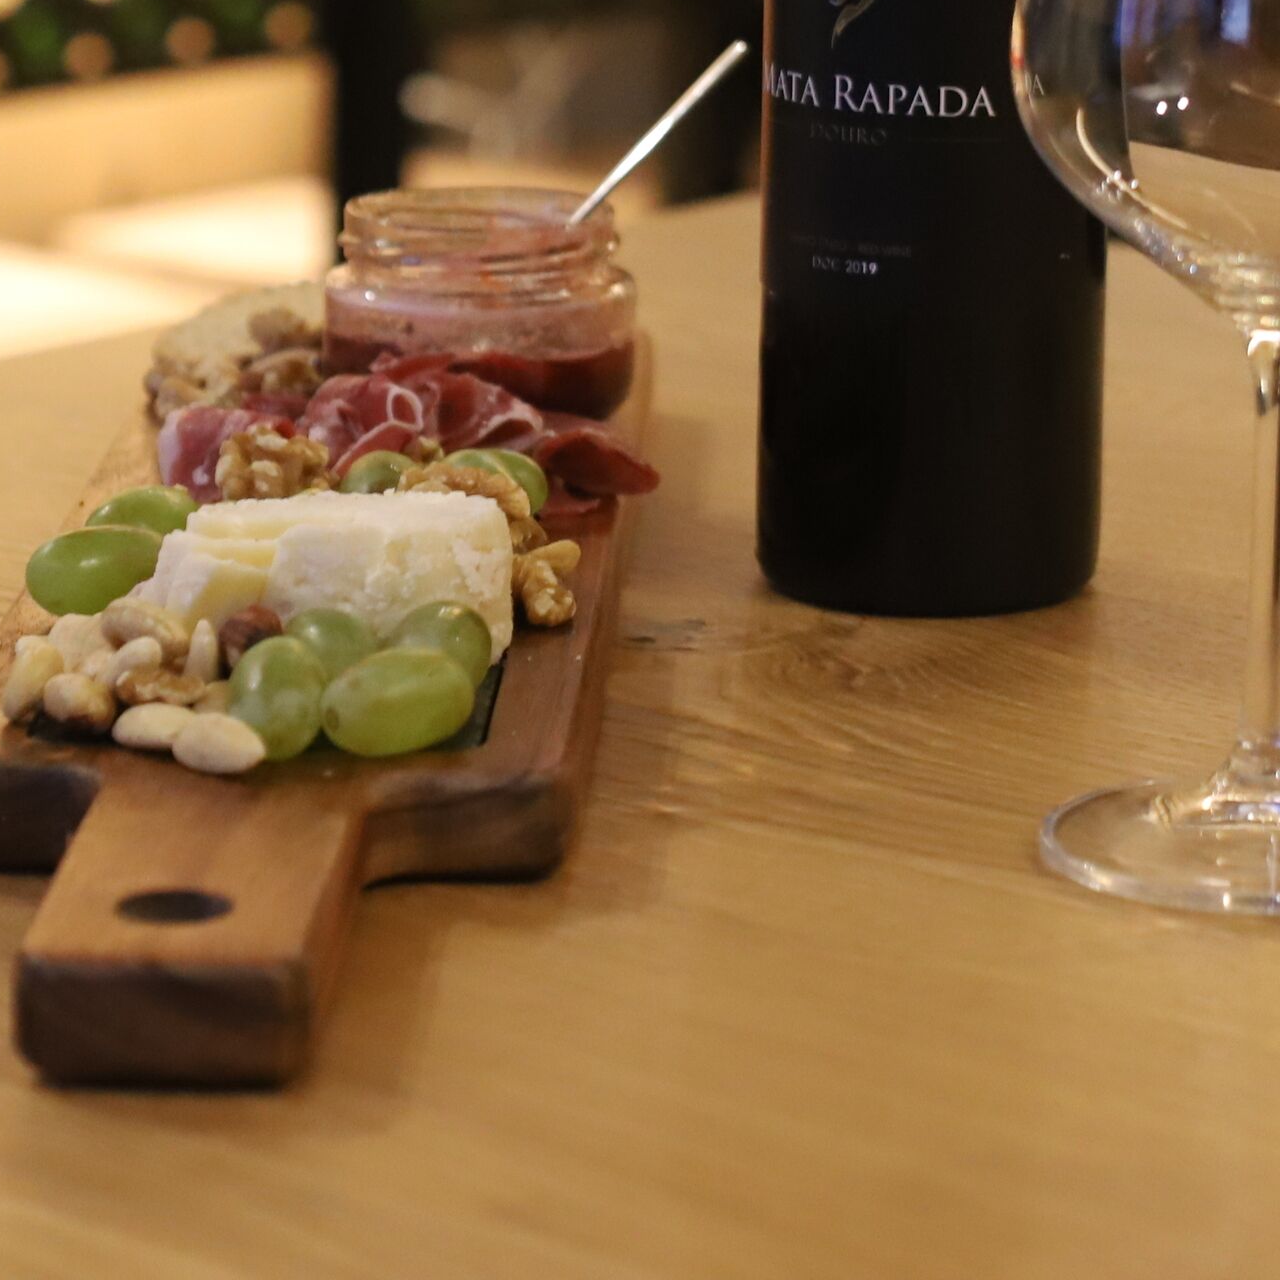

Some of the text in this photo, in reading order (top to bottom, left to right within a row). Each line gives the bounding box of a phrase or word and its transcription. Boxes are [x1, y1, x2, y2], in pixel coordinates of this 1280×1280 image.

[833, 73, 997, 119] RAPADA
[809, 120, 888, 146] DOURO
[845, 258, 879, 275] 2019
